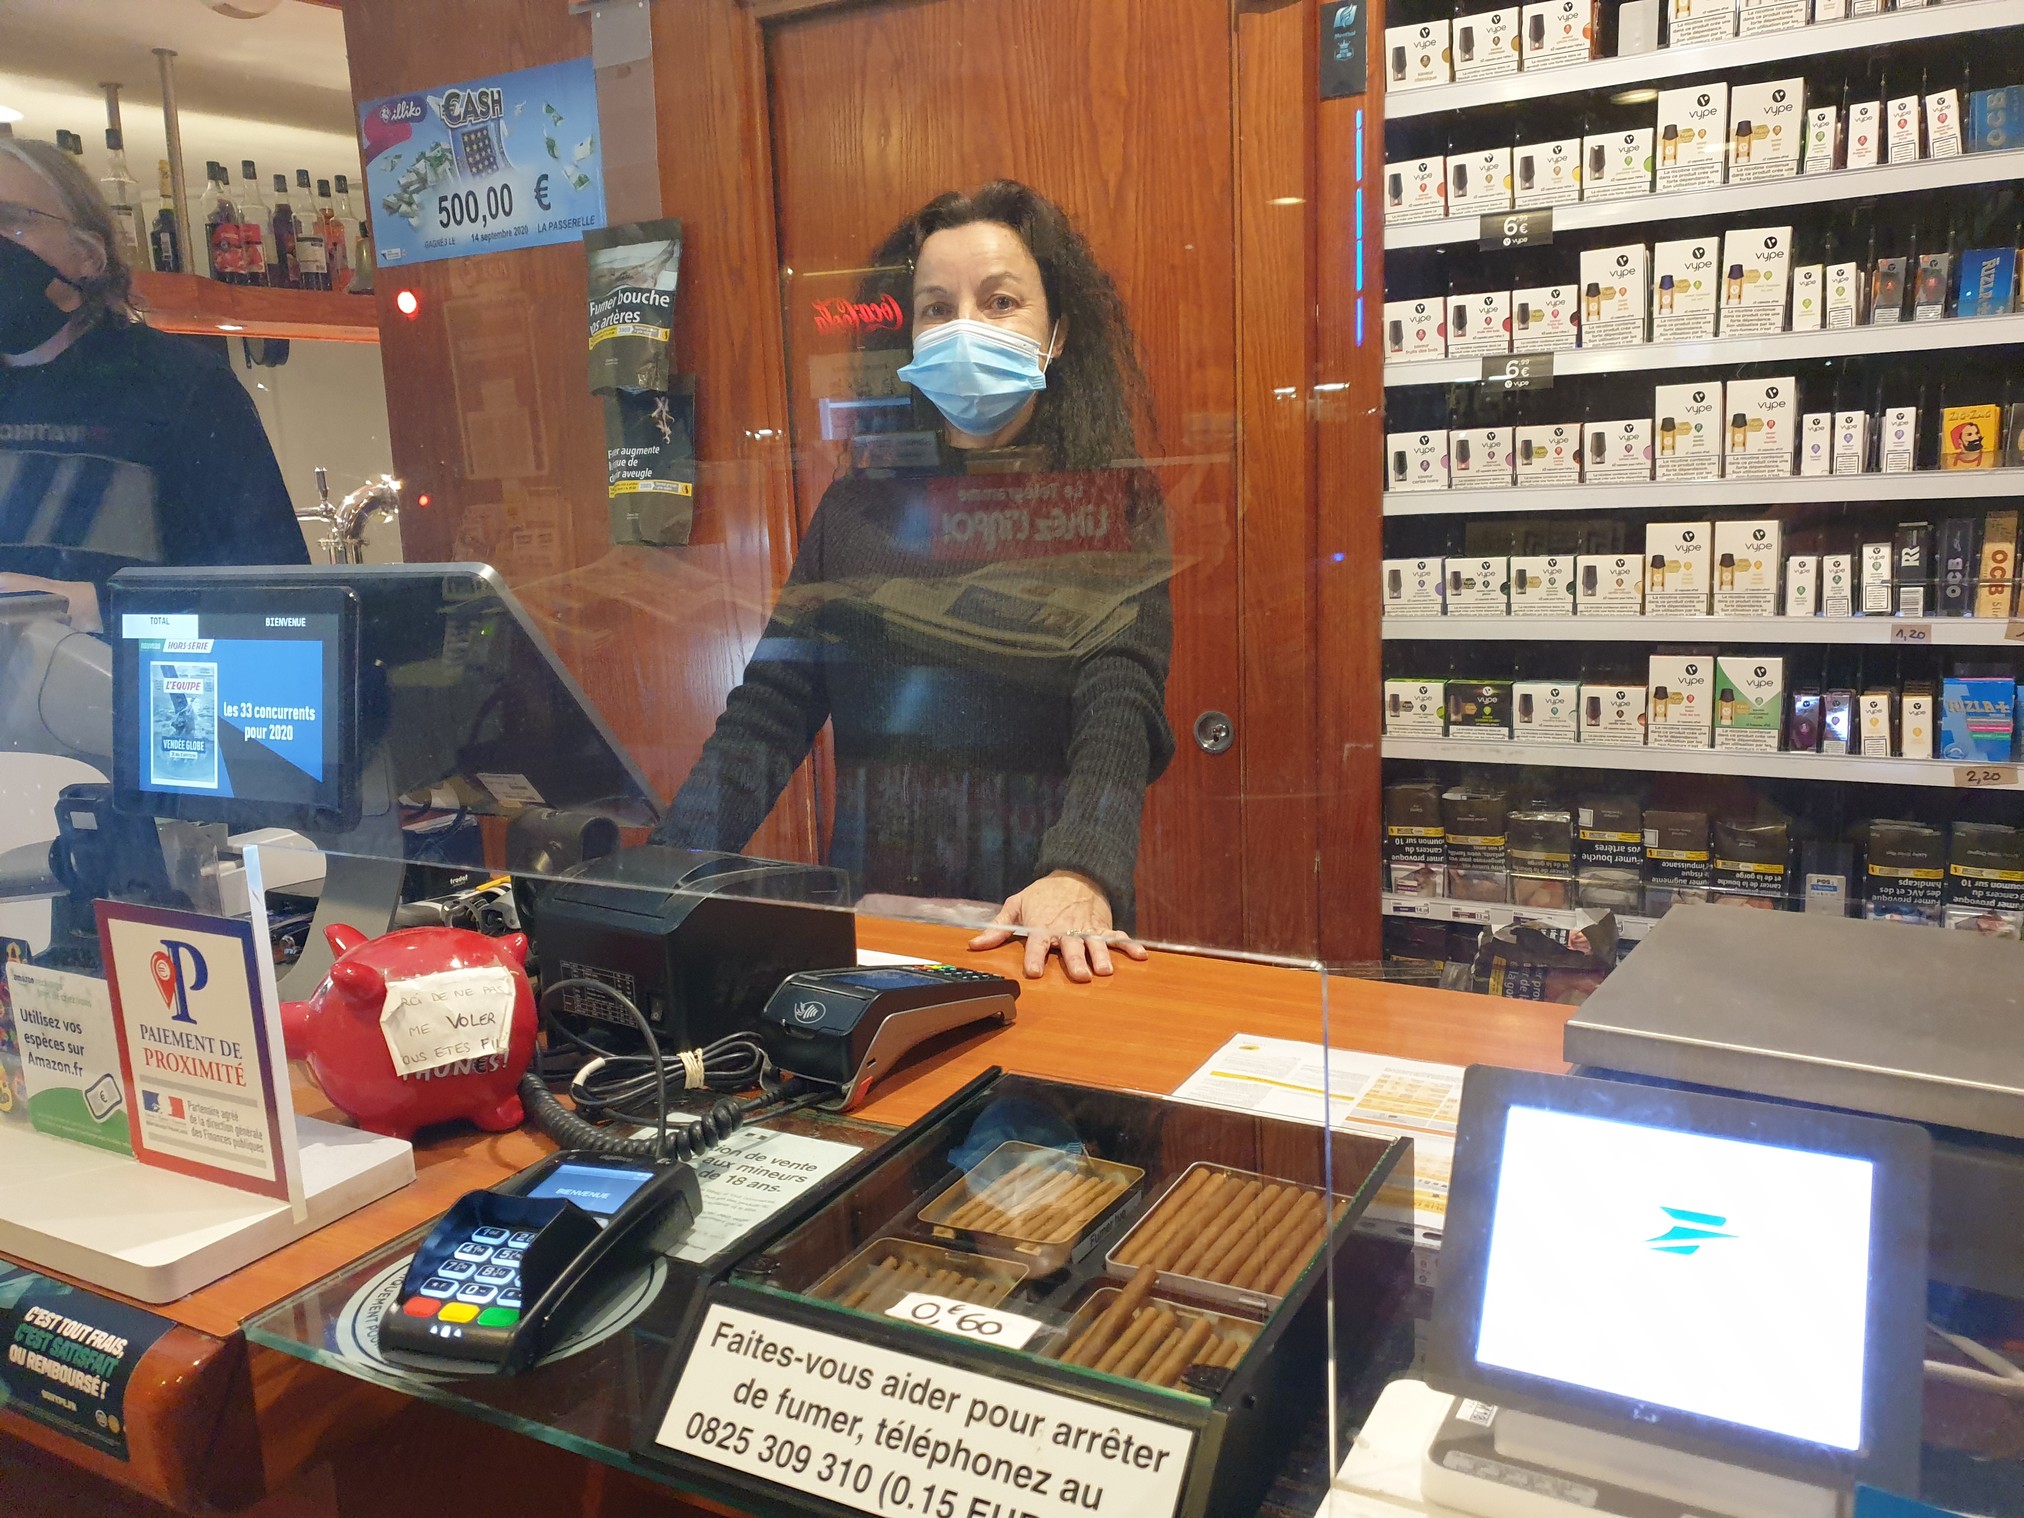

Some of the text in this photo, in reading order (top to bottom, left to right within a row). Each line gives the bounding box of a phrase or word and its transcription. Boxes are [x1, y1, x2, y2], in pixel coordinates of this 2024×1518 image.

[1413, 39, 1436, 50] vype
[442, 88, 504, 128] CASH
[1689, 107, 1717, 120] vype
[1764, 102, 1793, 116] vype
[1618, 144, 1640, 154] vype
[438, 174, 551, 229] 500,00 €
[480, 228, 512, 243] septembre
[513, 225, 529, 236] 2020
[537, 222, 547, 233] LA
[548, 215, 595, 231] PASSERELLE
[1756, 251, 1784, 261] vype
[1685, 261, 1712, 271] vype
[1609, 267, 1635, 279] vype
[617, 289, 669, 307] bouche
[600, 309, 640, 328] artères
[1685, 404, 1712, 415] vype
[1758, 400, 1786, 410] vype
[621, 446, 660, 457] augmente
[628, 458, 638, 466] de
[622, 468, 652, 479] aveugle
[1675, 544, 1701, 553] vype
[1745, 542, 1772, 551] vype
[1988, 550, 2008, 596] OCB
[150, 617, 170, 625] TOTAL
[265, 617, 306, 627] BIENVENUE
[1896, 629, 1925, 640] 1,20
[1678, 678, 1704, 686] vype
[1746, 679, 1773, 689] vype
[224, 702, 315, 720] les 33 concurrents
[244, 725, 293, 741] pour 2020
[163, 738, 204, 751] VENDÉE GLOBE
[1967, 771, 2001, 784] 2,20
[1595, 844, 1626, 854] artères
[1582, 853, 1612, 863] bouche
[1736, 872, 1755, 880] gorge
[1898, 879, 1942, 888] handicaps
[1961, 879, 1972, 887] 10
[1880, 887, 1894, 895] des
[432, 992, 446, 1002] DE
[454, 988, 473, 996] NE
[20, 1007, 82, 1035] Utilisez vos
[409, 1012, 495, 1037] ME VOLER
[24, 1031, 84, 1056] espèces sur
[140, 1023, 242, 1059] PAIEMENT DE
[435, 1042, 470, 1058] ETES
[28, 1051, 83, 1077] Amazon.fr
[143, 1047, 246, 1087] PROXIMITÉ
[744, 1151, 768, 1163] de
[771, 1157, 817, 1172] vente
[702, 1157, 807, 1183] aux mineurs
[699, 1170, 781, 1192] de 18 ans.
[556, 1188, 610, 1200] BIENVENUE
[24, 1306, 128, 1359] C'EST TOUT FRAIS,
[50, 1336, 119, 1378] SATISFAIT
[9, 1345, 100, 1397] OU REMBOURSÉ
[710, 1321, 1171, 1473] Faites-vous aider pour arrêter
[732, 1377, 770, 1409] de
[774, 1388, 864, 1444] fumer,
[874, 1417, 1052, 1495] téléphonez
[1059, 1477, 1103, 1512] au
[684, 1411, 752, 1456] 0825
[757, 1433, 812, 1474] 309
[817, 1452, 873, 1494] 310
[877, 1469, 957, 1518] (0.15
